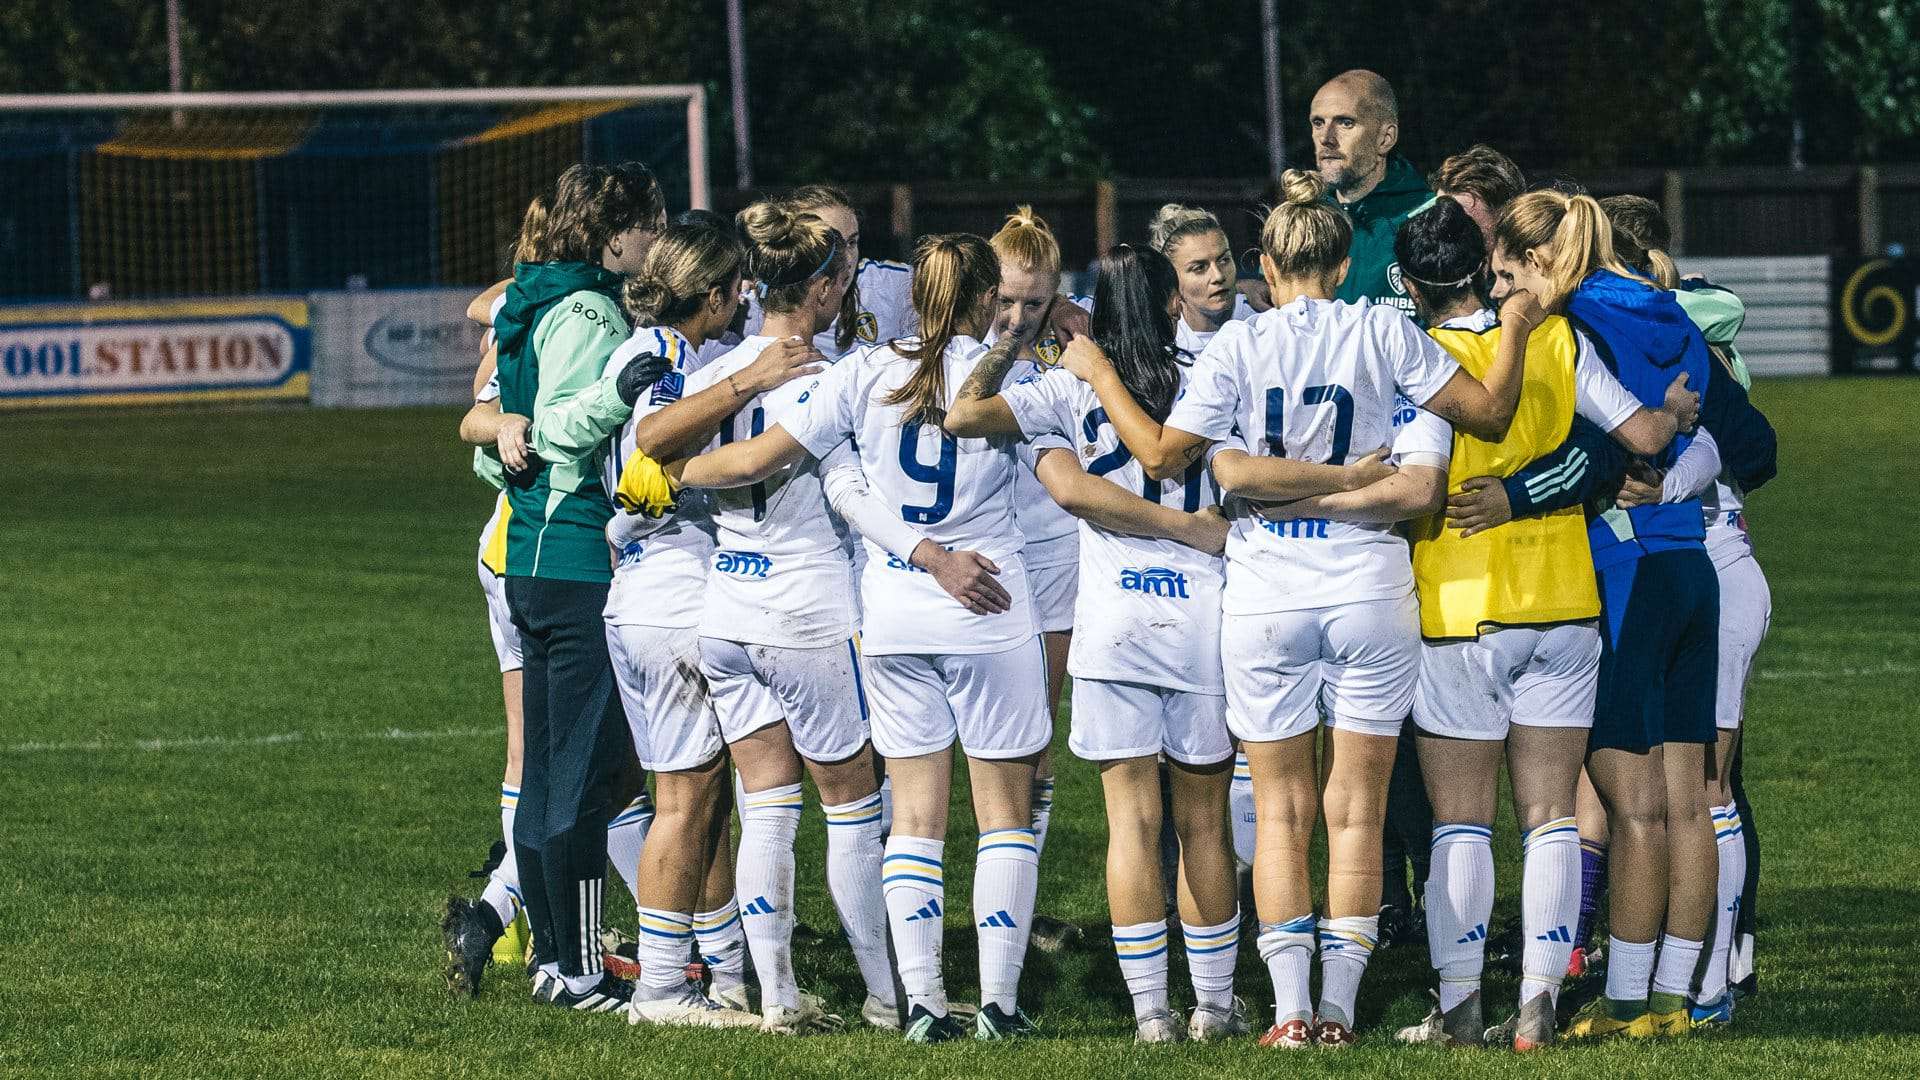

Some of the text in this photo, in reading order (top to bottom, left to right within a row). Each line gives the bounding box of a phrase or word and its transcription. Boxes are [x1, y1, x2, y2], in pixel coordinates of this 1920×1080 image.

[571, 301, 620, 337] BOXT
[1265, 383, 1354, 466] 17
[898, 409, 958, 525] 9
[716, 552, 773, 577] amt
[1120, 567, 1190, 599] amt
